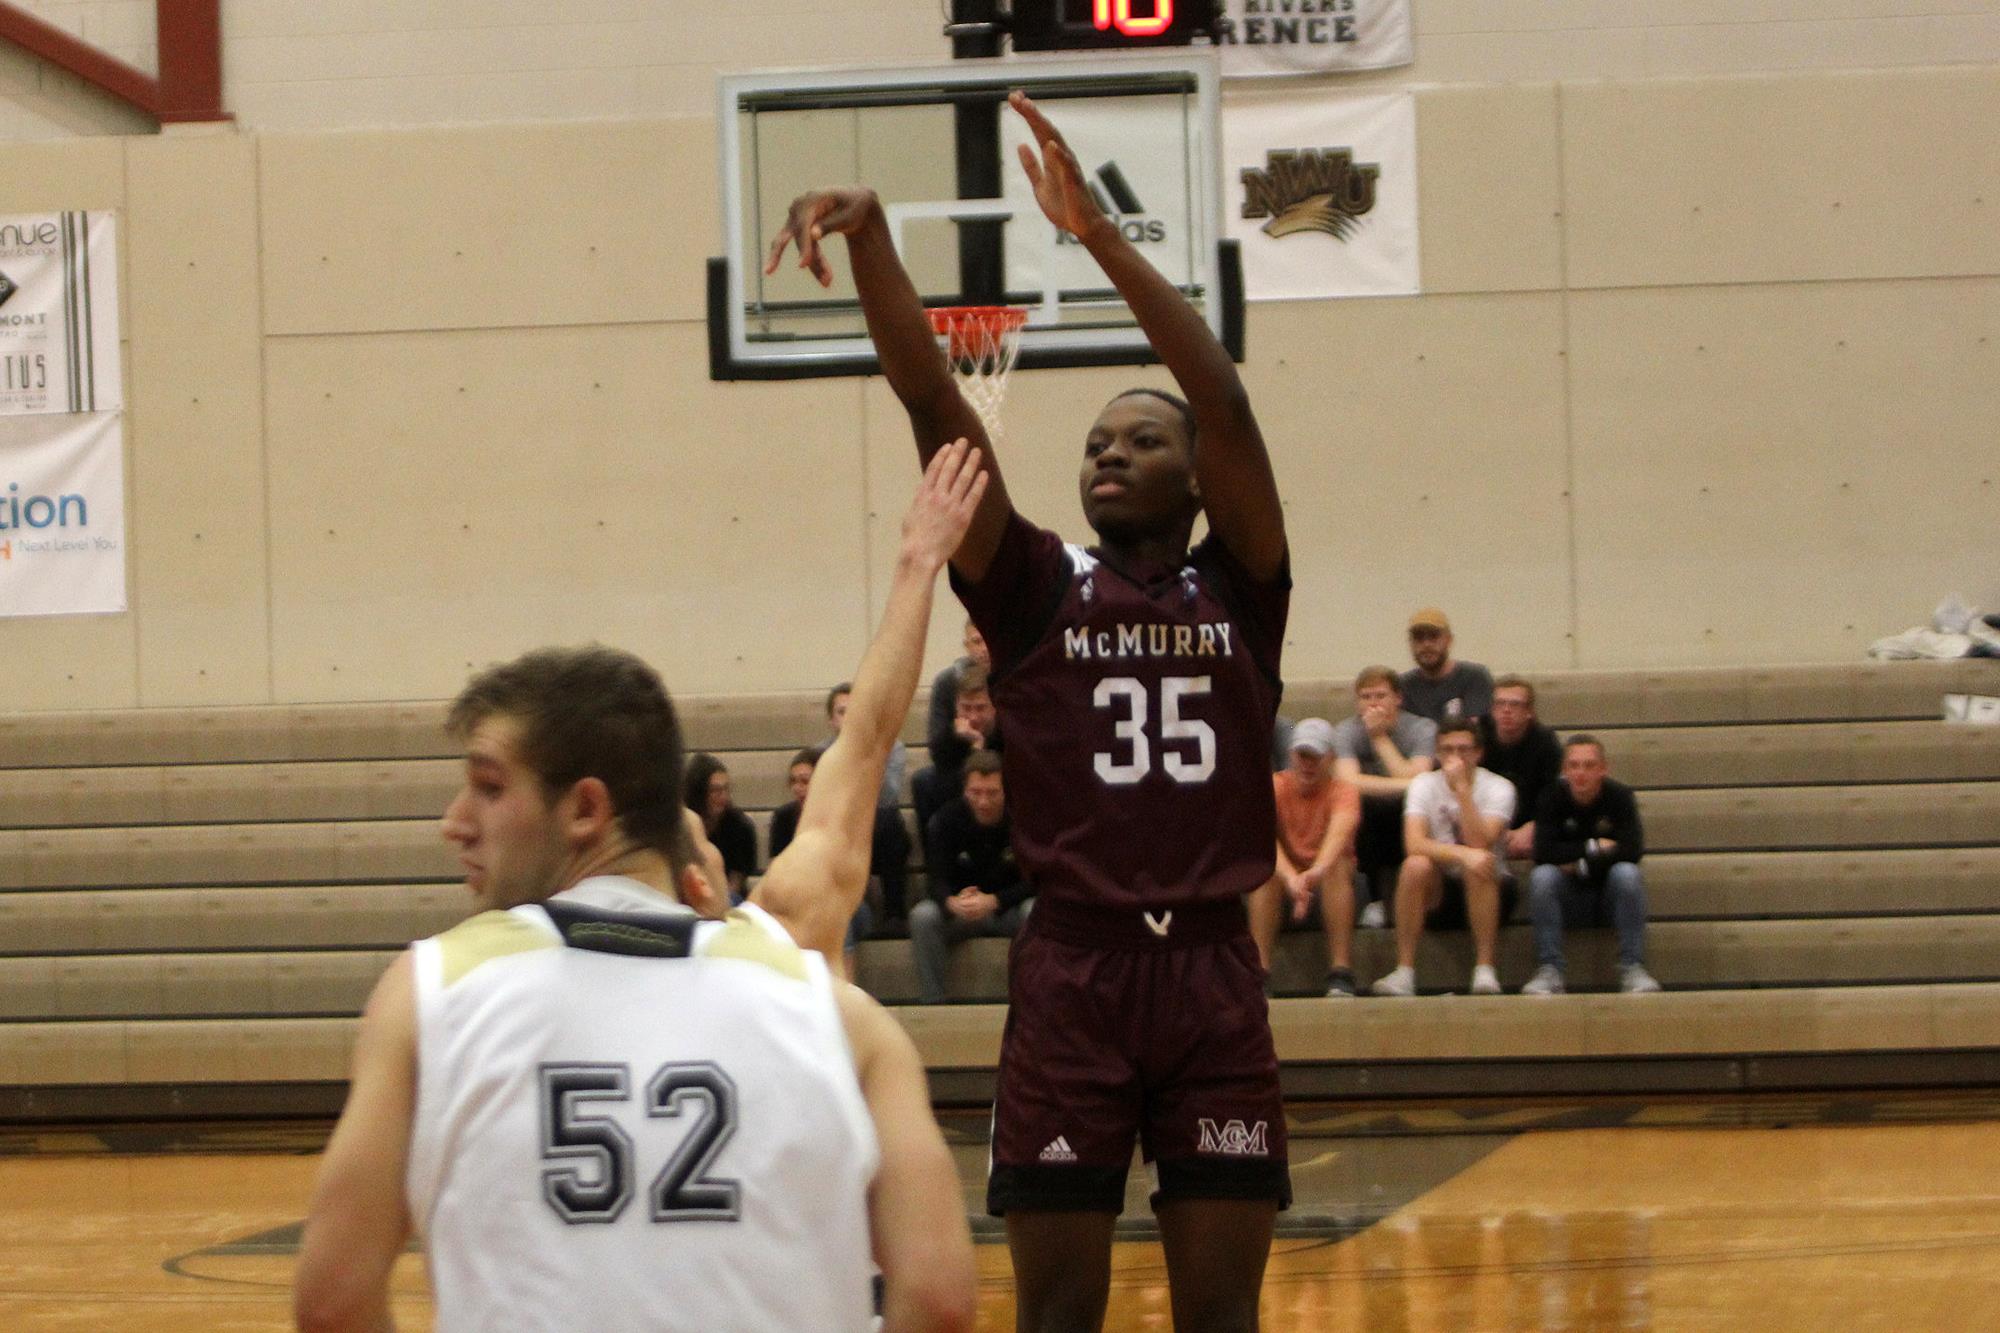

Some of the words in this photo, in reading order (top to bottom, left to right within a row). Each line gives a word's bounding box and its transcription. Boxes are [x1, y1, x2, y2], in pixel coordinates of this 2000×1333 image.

[1240, 147, 1381, 218] NWU
[0, 222, 57, 247] nue
[1092, 675, 1217, 785] 35
[538, 1061, 742, 1225] 52
